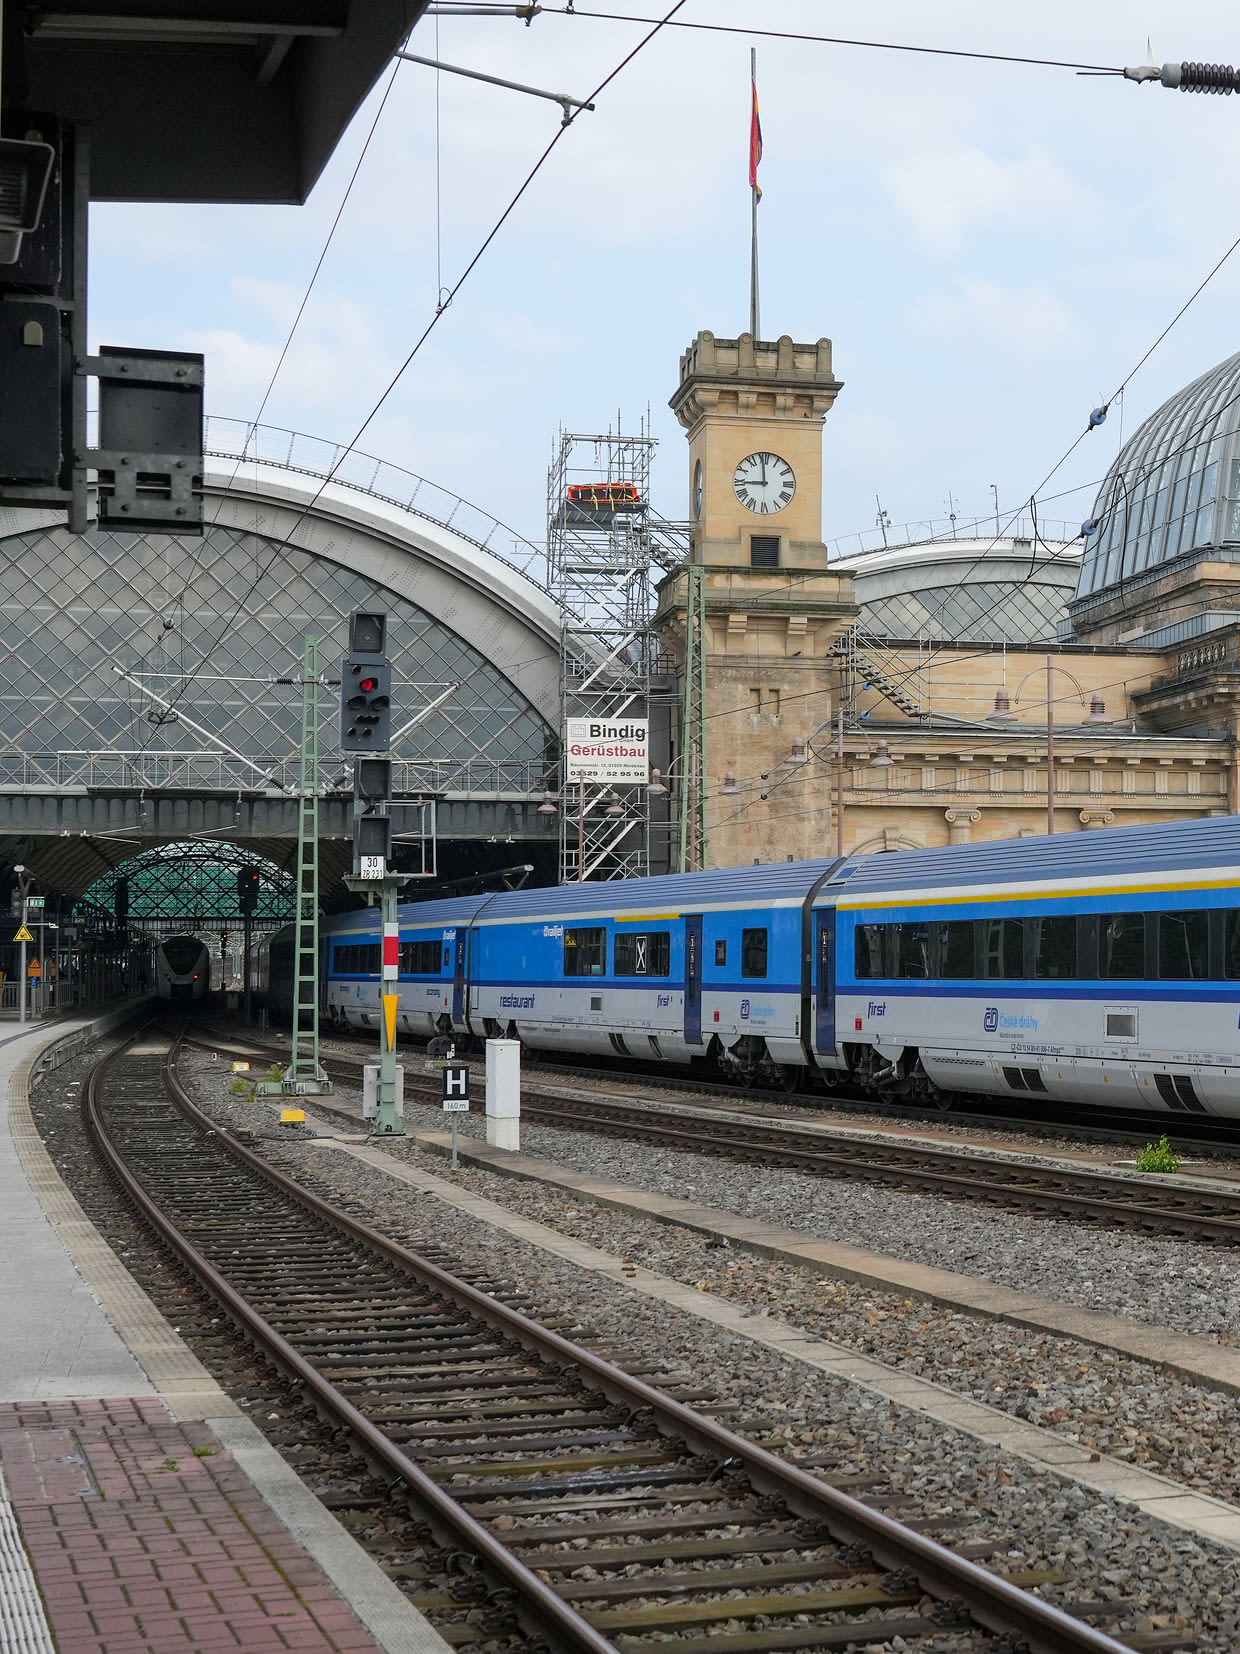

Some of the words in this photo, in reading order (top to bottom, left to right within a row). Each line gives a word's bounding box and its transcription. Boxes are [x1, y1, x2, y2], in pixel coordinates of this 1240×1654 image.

[590, 724, 646, 742] Bindig
[571, 744, 646, 757] Gerüstbau
[368, 857, 378, 867] 30
[500, 994, 535, 1008] restaurant
[868, 1002, 886, 1019] first
[447, 1070, 465, 1094] H
